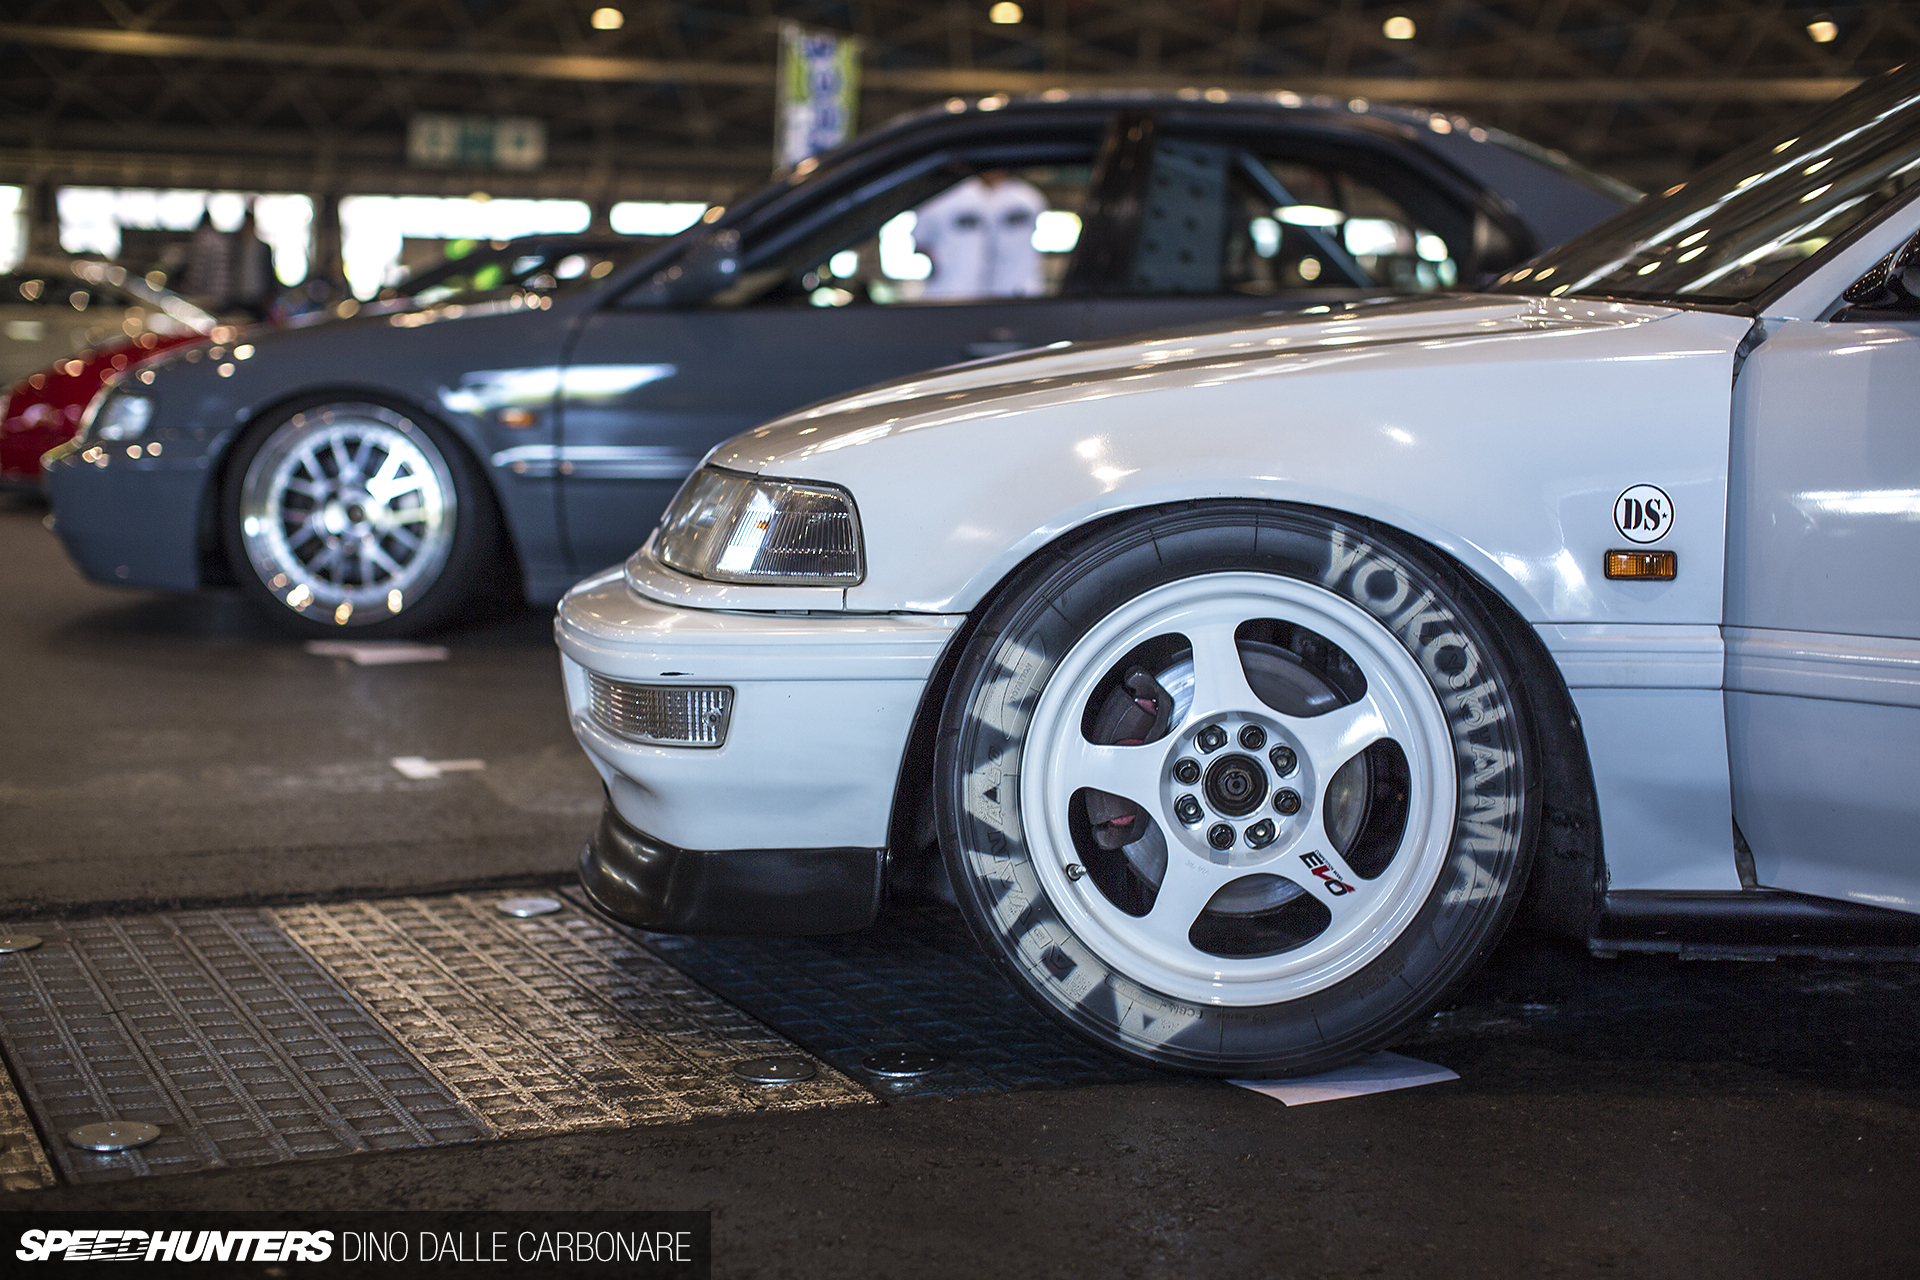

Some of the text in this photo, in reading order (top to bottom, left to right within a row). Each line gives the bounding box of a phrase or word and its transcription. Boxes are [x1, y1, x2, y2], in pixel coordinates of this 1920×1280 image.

[963, 637, 1201, 1053] ADVAN
[1299, 851, 1355, 896] EVO
[1324, 527, 1517, 906] YOKOHAMA
